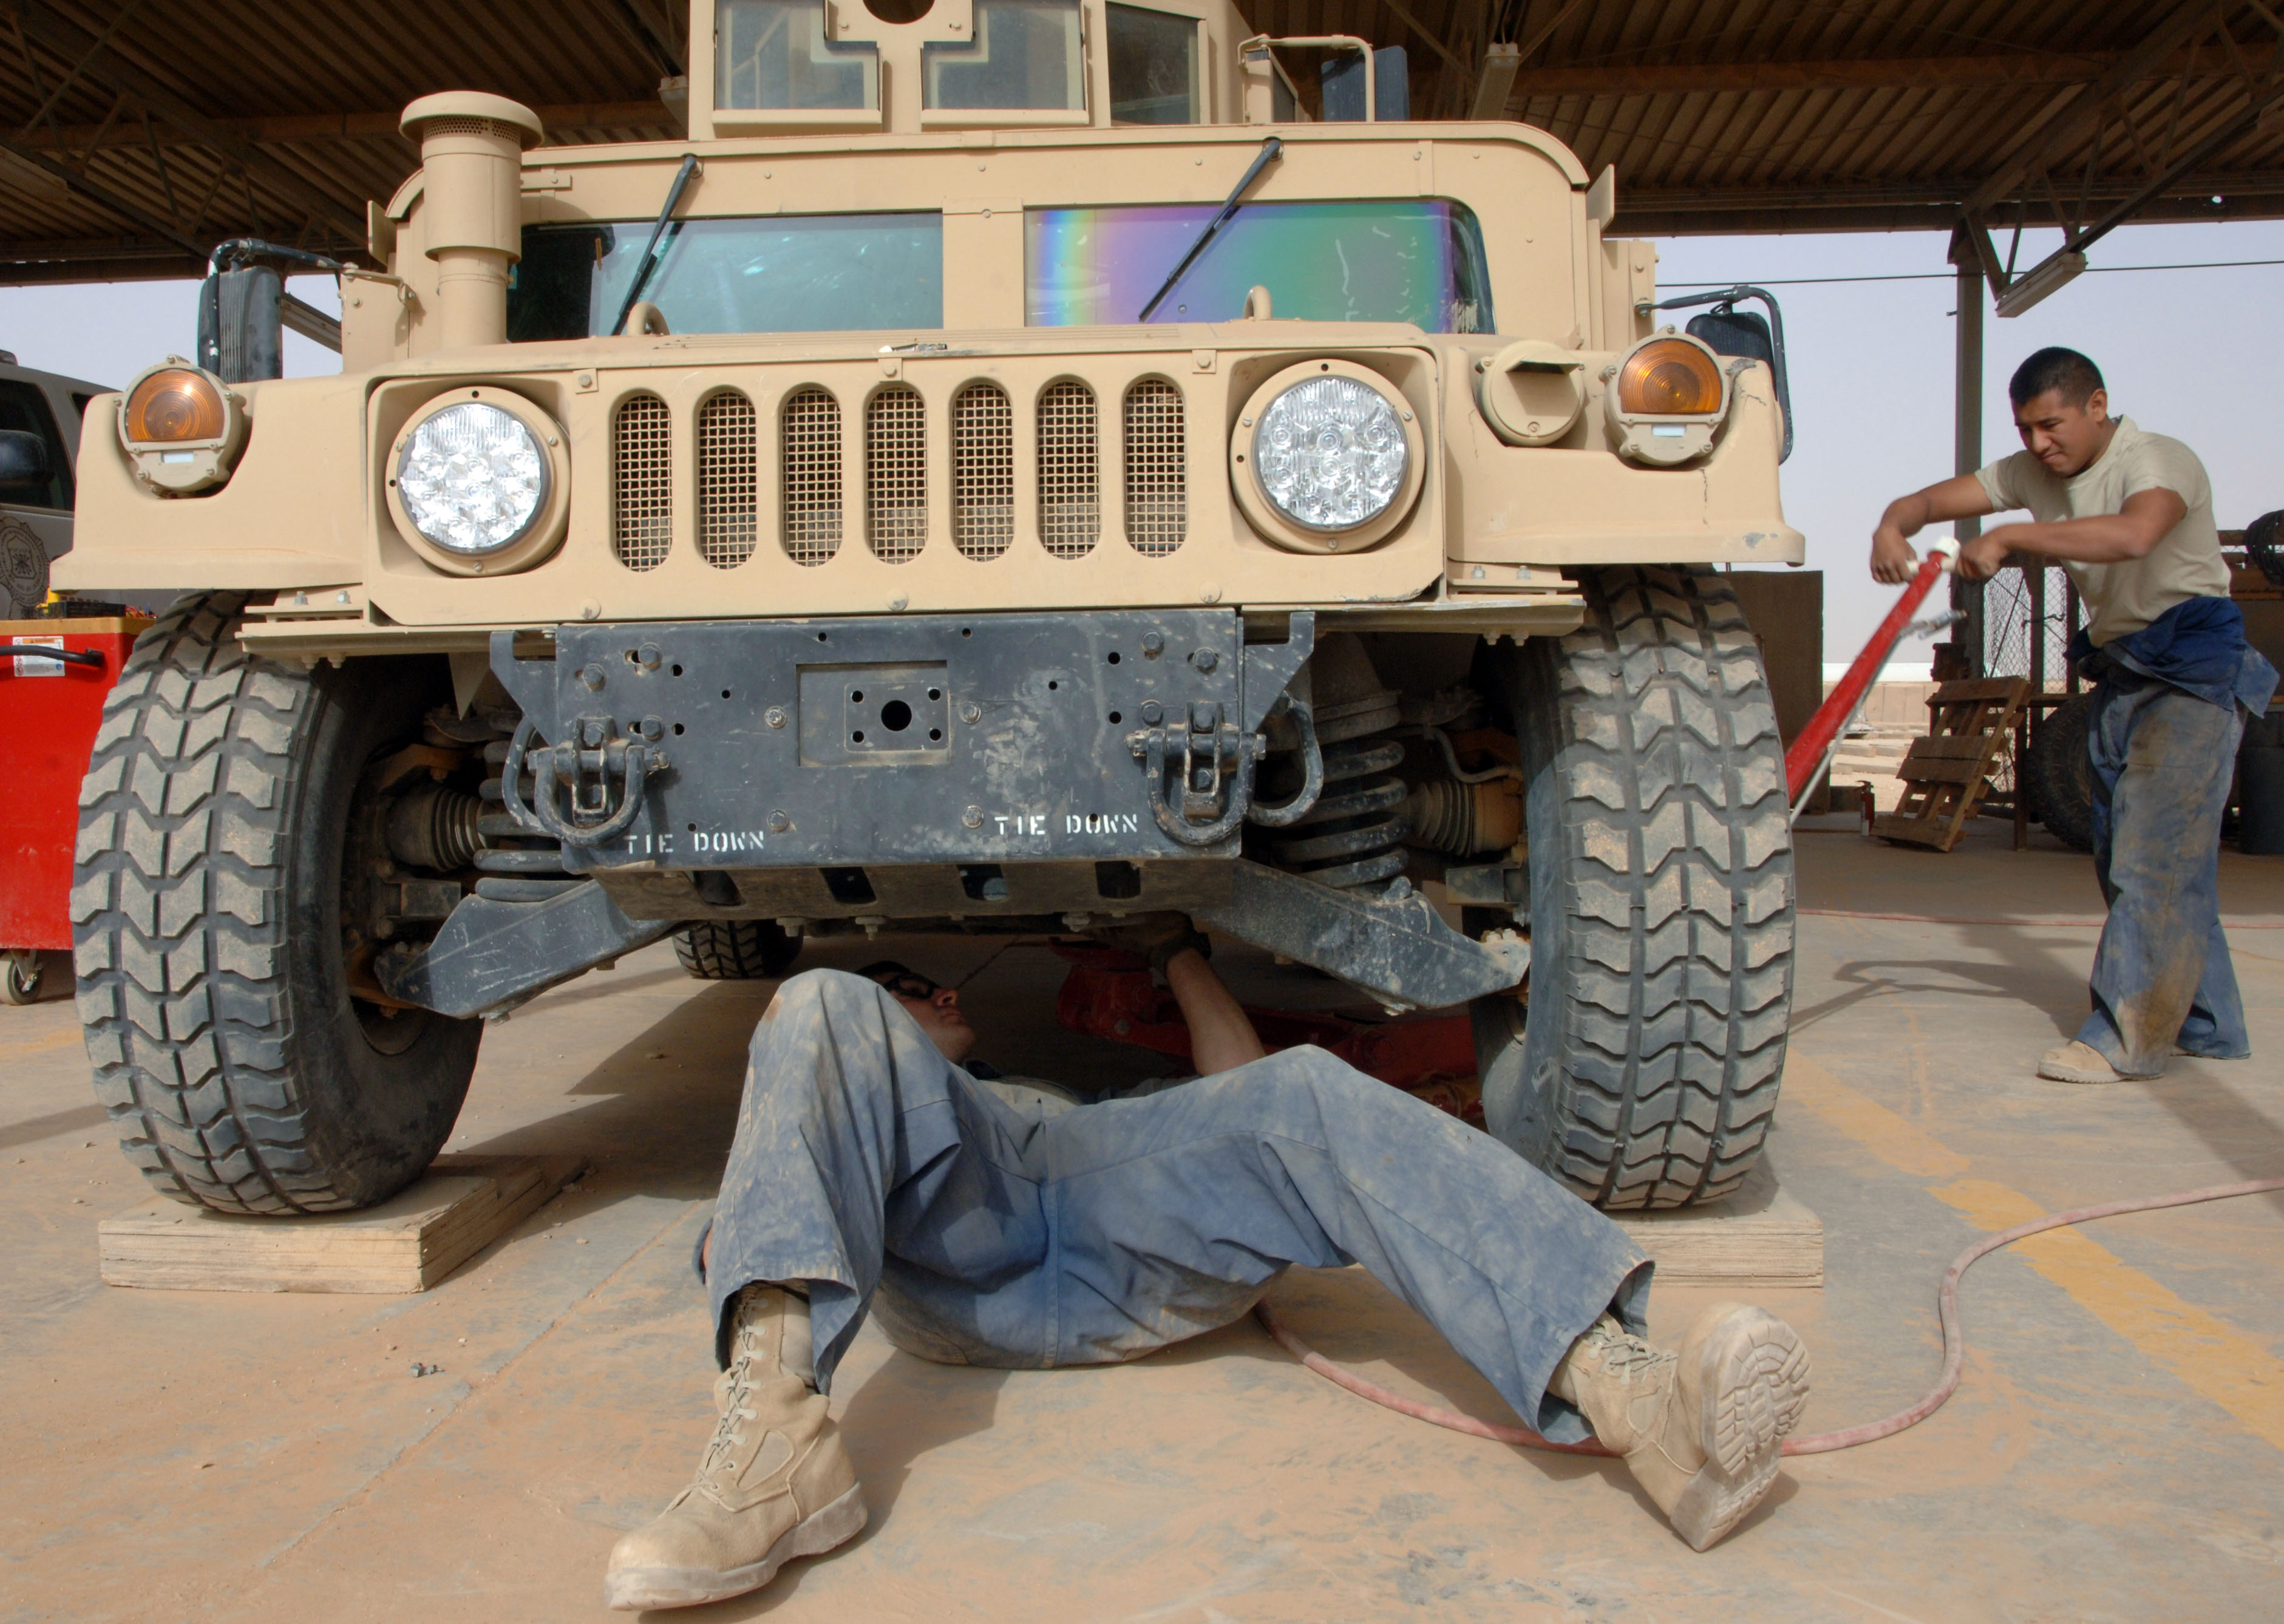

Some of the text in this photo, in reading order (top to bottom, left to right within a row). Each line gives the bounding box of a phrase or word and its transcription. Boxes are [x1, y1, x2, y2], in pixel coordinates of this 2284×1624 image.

[994, 814, 1137, 835] TIE DOWN
[624, 831, 763, 854] TIE DOWN
